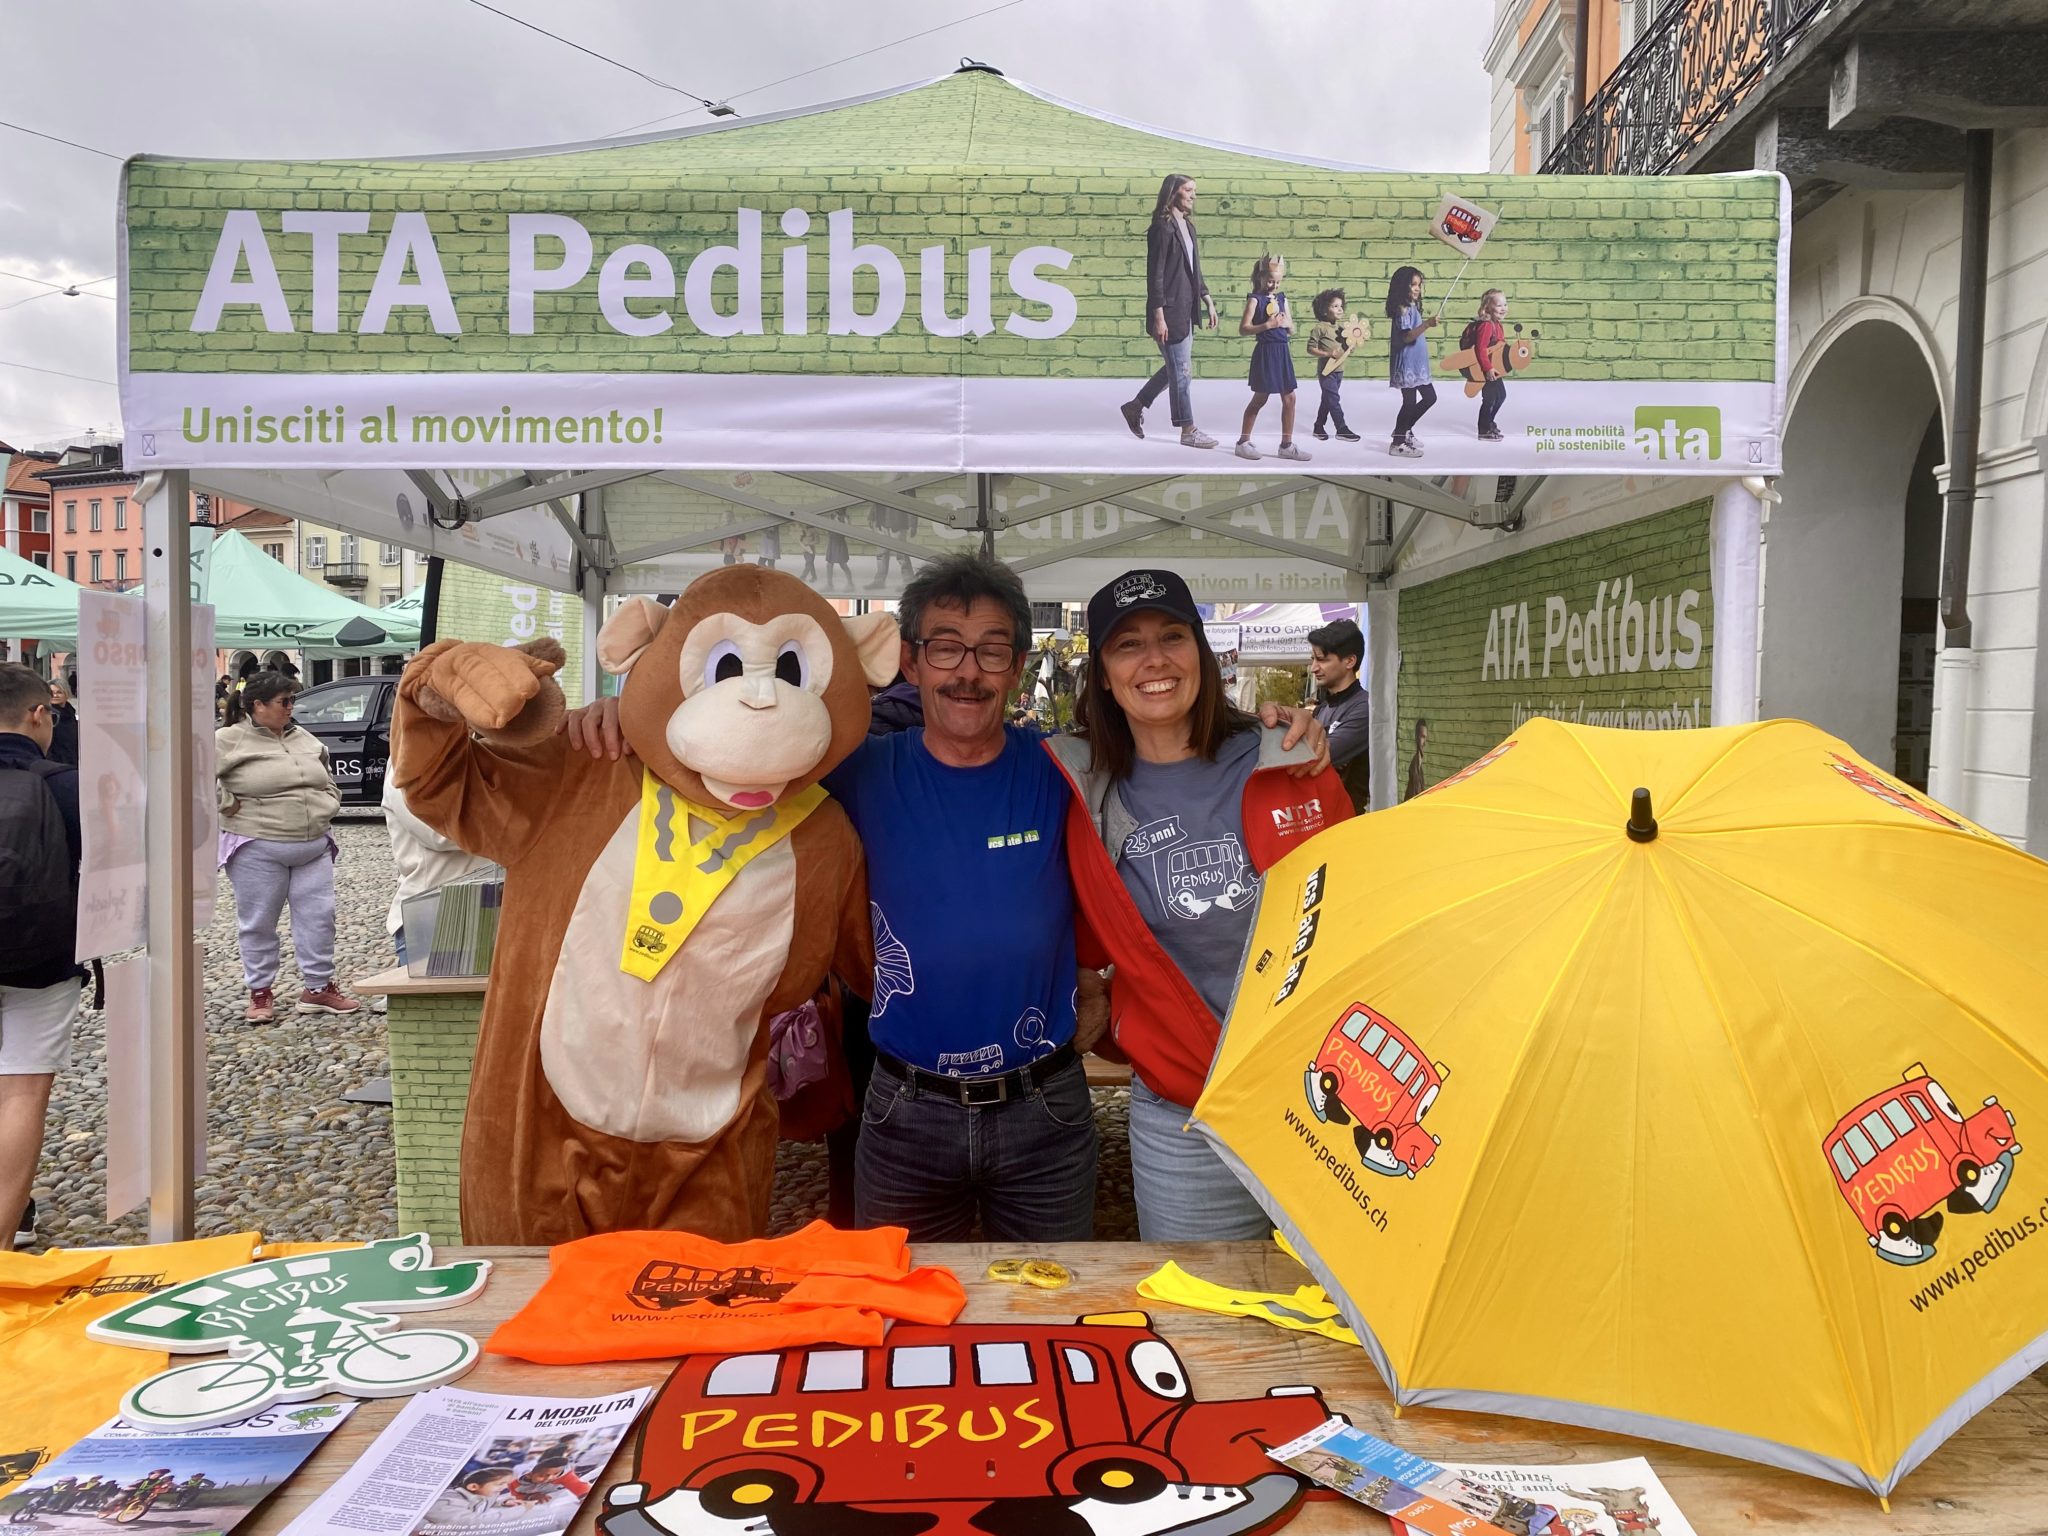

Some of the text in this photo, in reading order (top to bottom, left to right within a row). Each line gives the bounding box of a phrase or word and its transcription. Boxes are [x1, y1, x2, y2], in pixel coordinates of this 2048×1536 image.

[188, 207, 1078, 340] ATA Pedibus
[182, 405, 663, 444] Unisciti al movimento!
[1526, 425, 1625, 437] Per una mobilità
[1635, 419, 1711, 460] ata
[1536, 438, 1626, 453] più sostenibile
[243, 622, 318, 638] SKO
[1245, 625, 1281, 634] FOTO
[1481, 574, 1703, 681] ATA Pedibus
[1271, 799, 1322, 825] NTR
[1126, 823, 1176, 854] 25 anni
[1172, 867, 1224, 888] PEDIBUS
[1278, 959, 1301, 1001] ata
[1326, 1036, 1399, 1113] PEDIBUS
[1284, 1107, 1389, 1233] www.pedibus.ch
[1851, 1138, 1941, 1215] PEDIBUS
[505, 1394, 636, 1421] LA MOBILITÀ
[534, 1416, 597, 1429] DEL FUTURO
[680, 1398, 1055, 1451] PEDIBUS
[1457, 1468, 1553, 1483] Pedibus
